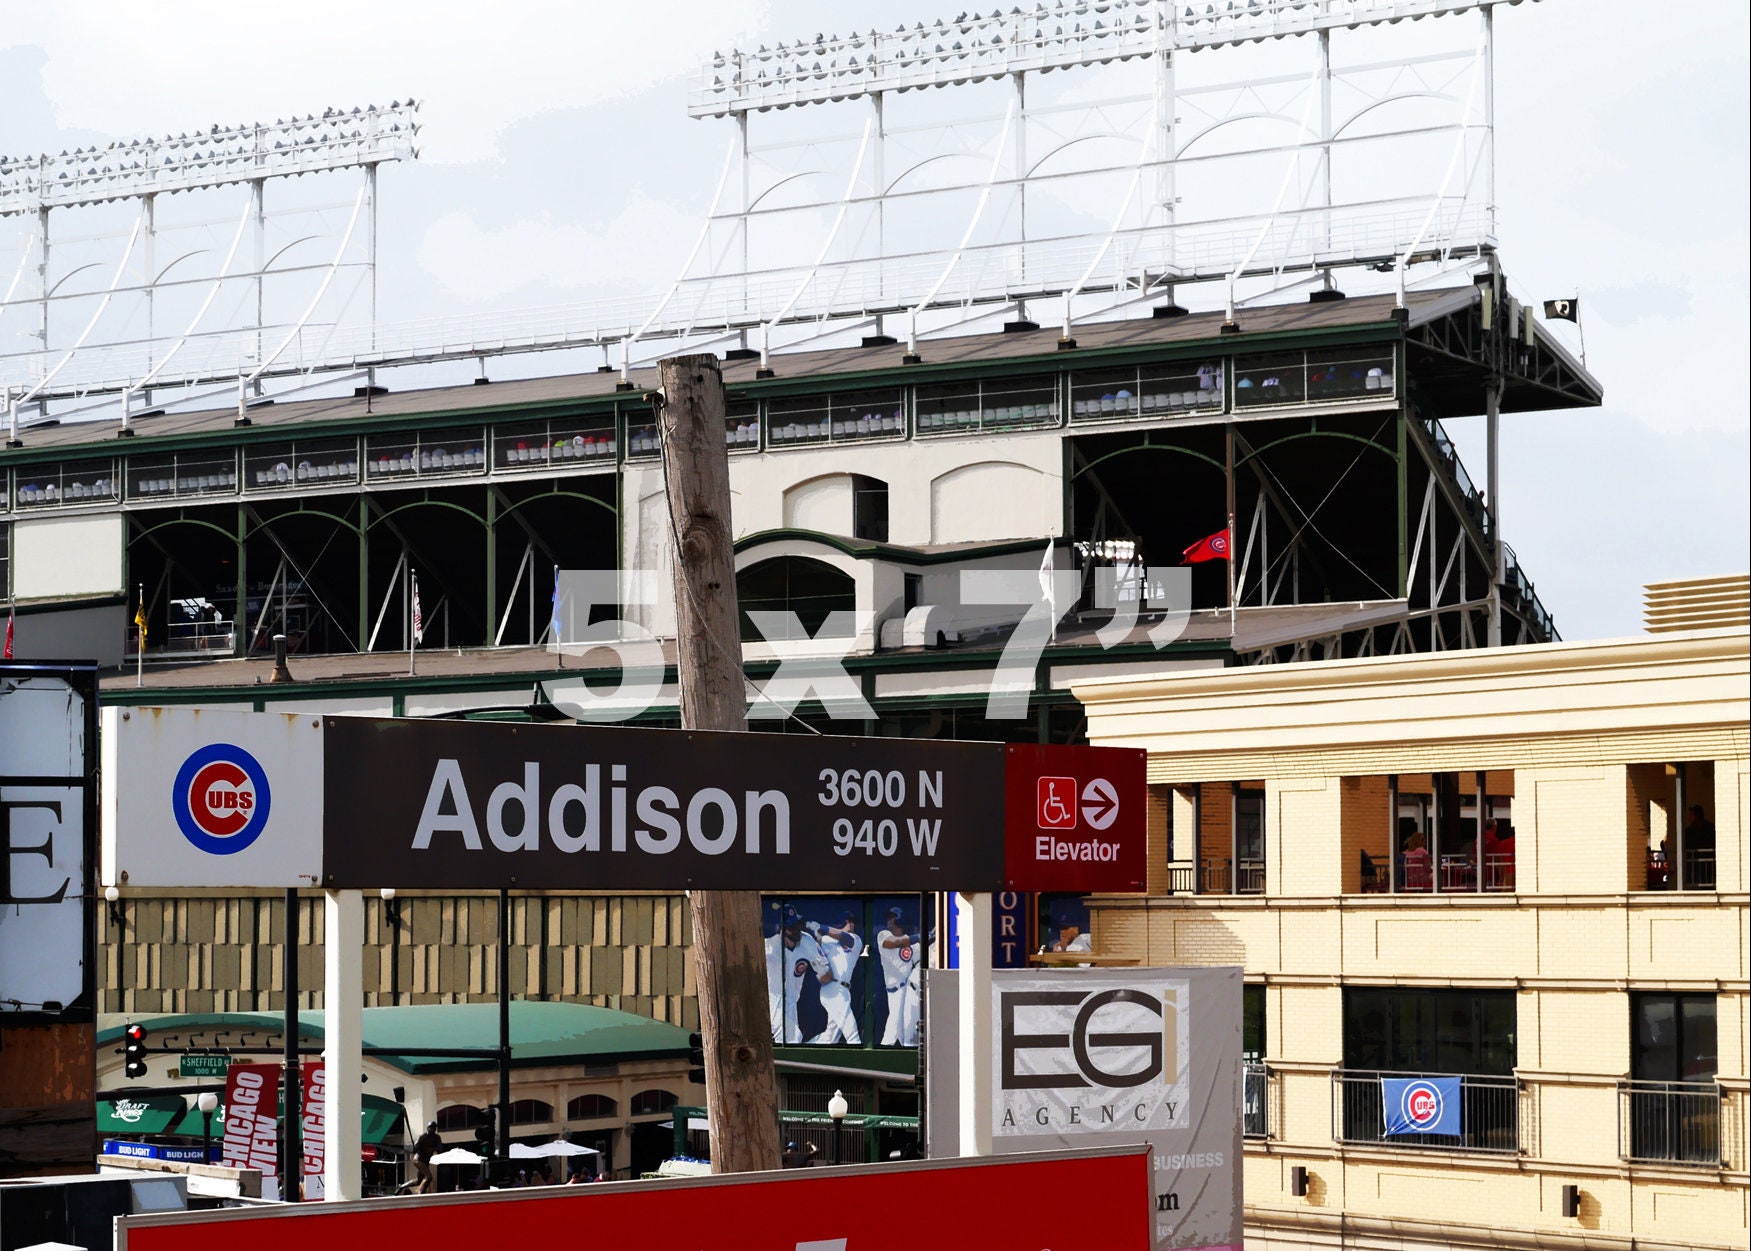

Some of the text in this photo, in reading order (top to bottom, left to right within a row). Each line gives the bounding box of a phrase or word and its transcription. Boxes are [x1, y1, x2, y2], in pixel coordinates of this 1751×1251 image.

[818, 768, 943, 808] 3600 N
[411, 758, 791, 855] Addison
[832, 818, 942, 857] 940 W
[1035, 836, 1121, 862] Elevator
[186, 1057, 223, 1067] SHEFFIELD
[115, 1102, 150, 1110] DRAFT
[1002, 1102, 1178, 1127] AGENCY
[118, 1145, 132, 1155] BUD
[132, 1146, 150, 1157] LIGHT
[1154, 1152, 1224, 1171] BUSINESS
